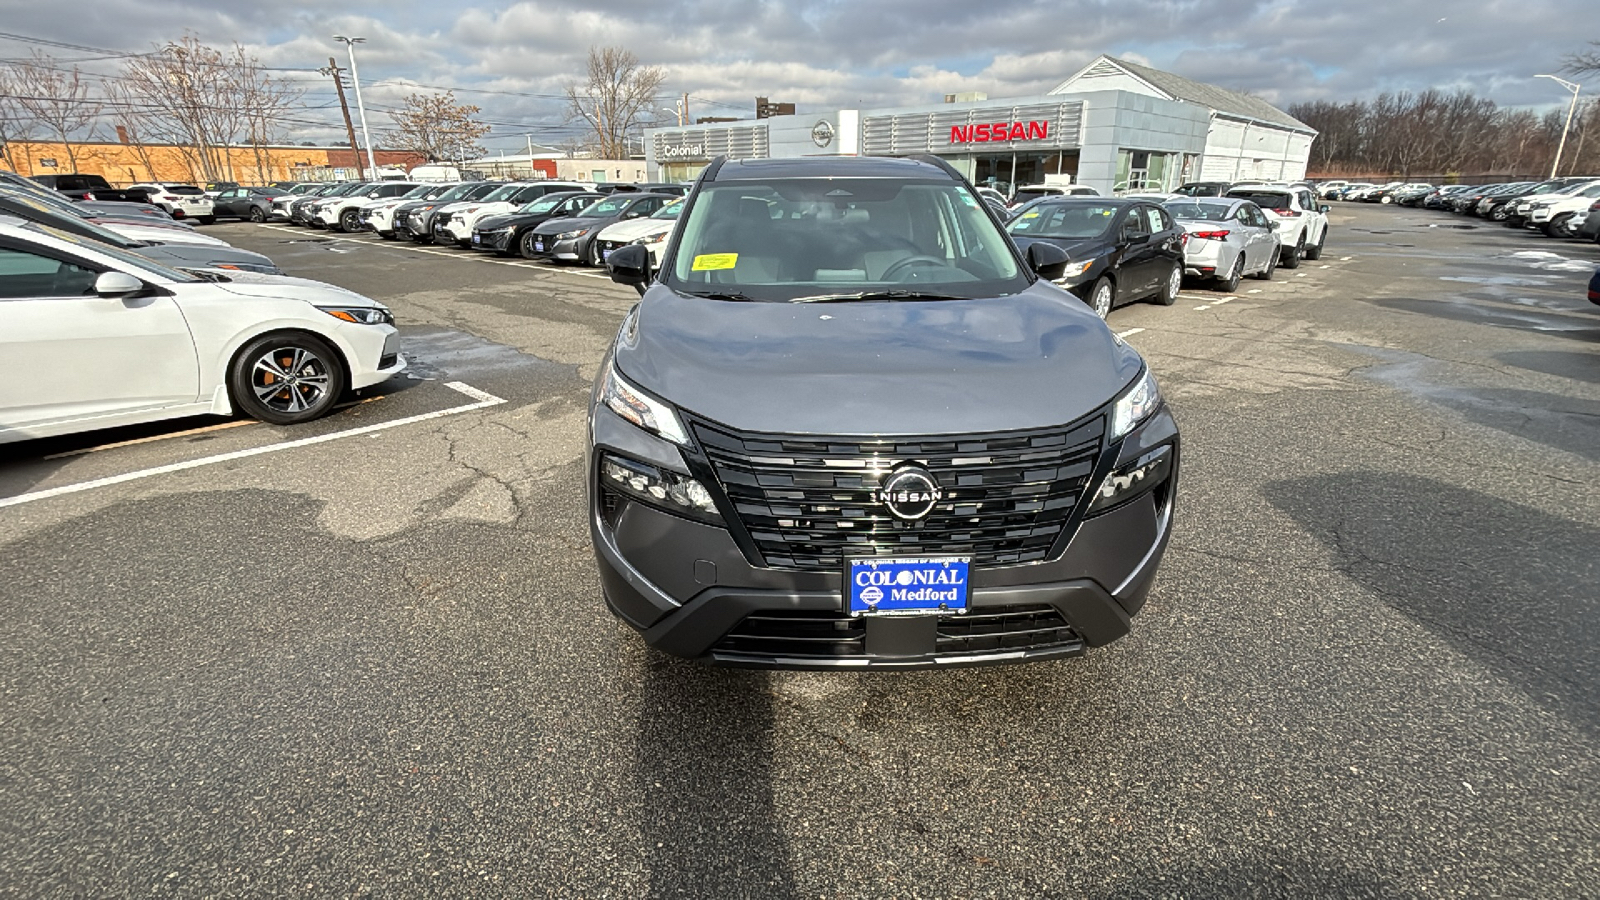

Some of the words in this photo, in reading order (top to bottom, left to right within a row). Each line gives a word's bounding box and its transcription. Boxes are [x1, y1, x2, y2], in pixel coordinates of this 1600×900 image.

[951, 120, 1048, 143] NISSAN
[664, 143, 702, 157] Colonial
[880, 491, 942, 503] NISSAN
[856, 569, 964, 587] COLONIAL
[891, 588, 957, 601] Medford
